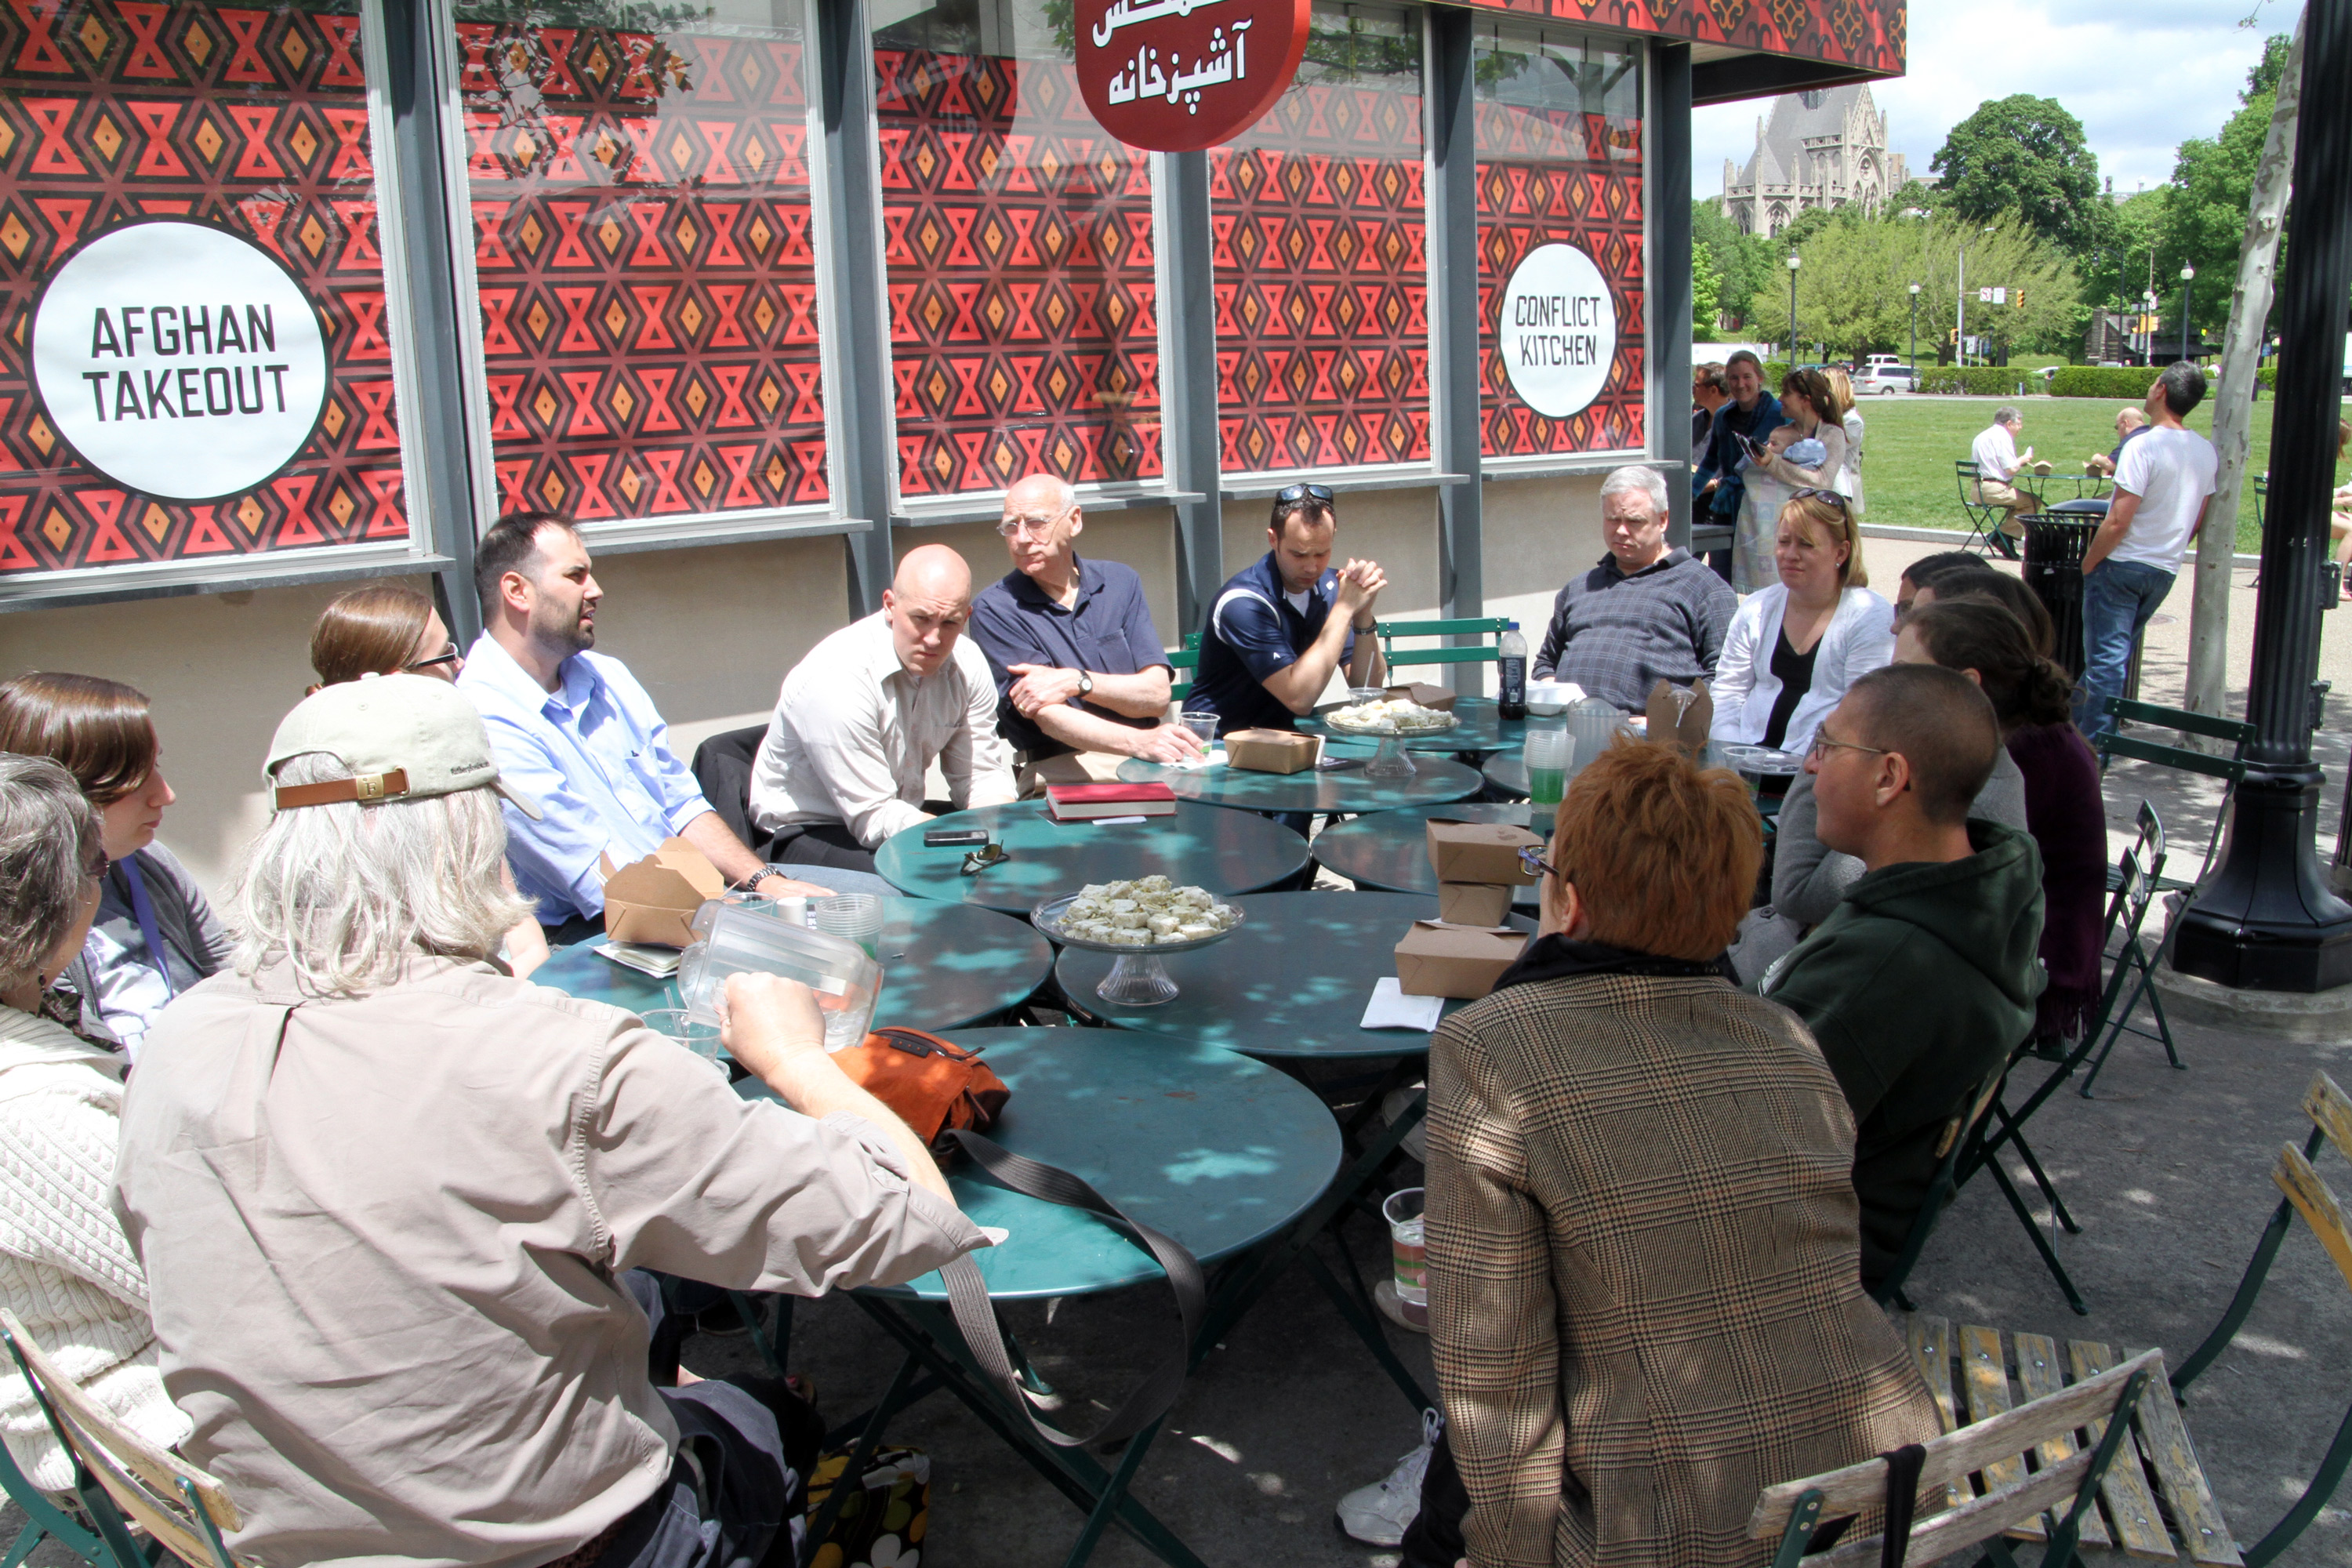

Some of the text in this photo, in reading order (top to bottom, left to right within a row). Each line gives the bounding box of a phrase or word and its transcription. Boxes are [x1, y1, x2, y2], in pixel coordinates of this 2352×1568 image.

[1109, 16, 1253, 115] آشپزخانه
[91, 303, 276, 358] AFGHAN
[1515, 296, 1601, 327] CONFLICT
[1520, 335, 1596, 366] KITCHEN
[82, 365, 289, 422] TAKEOUT
